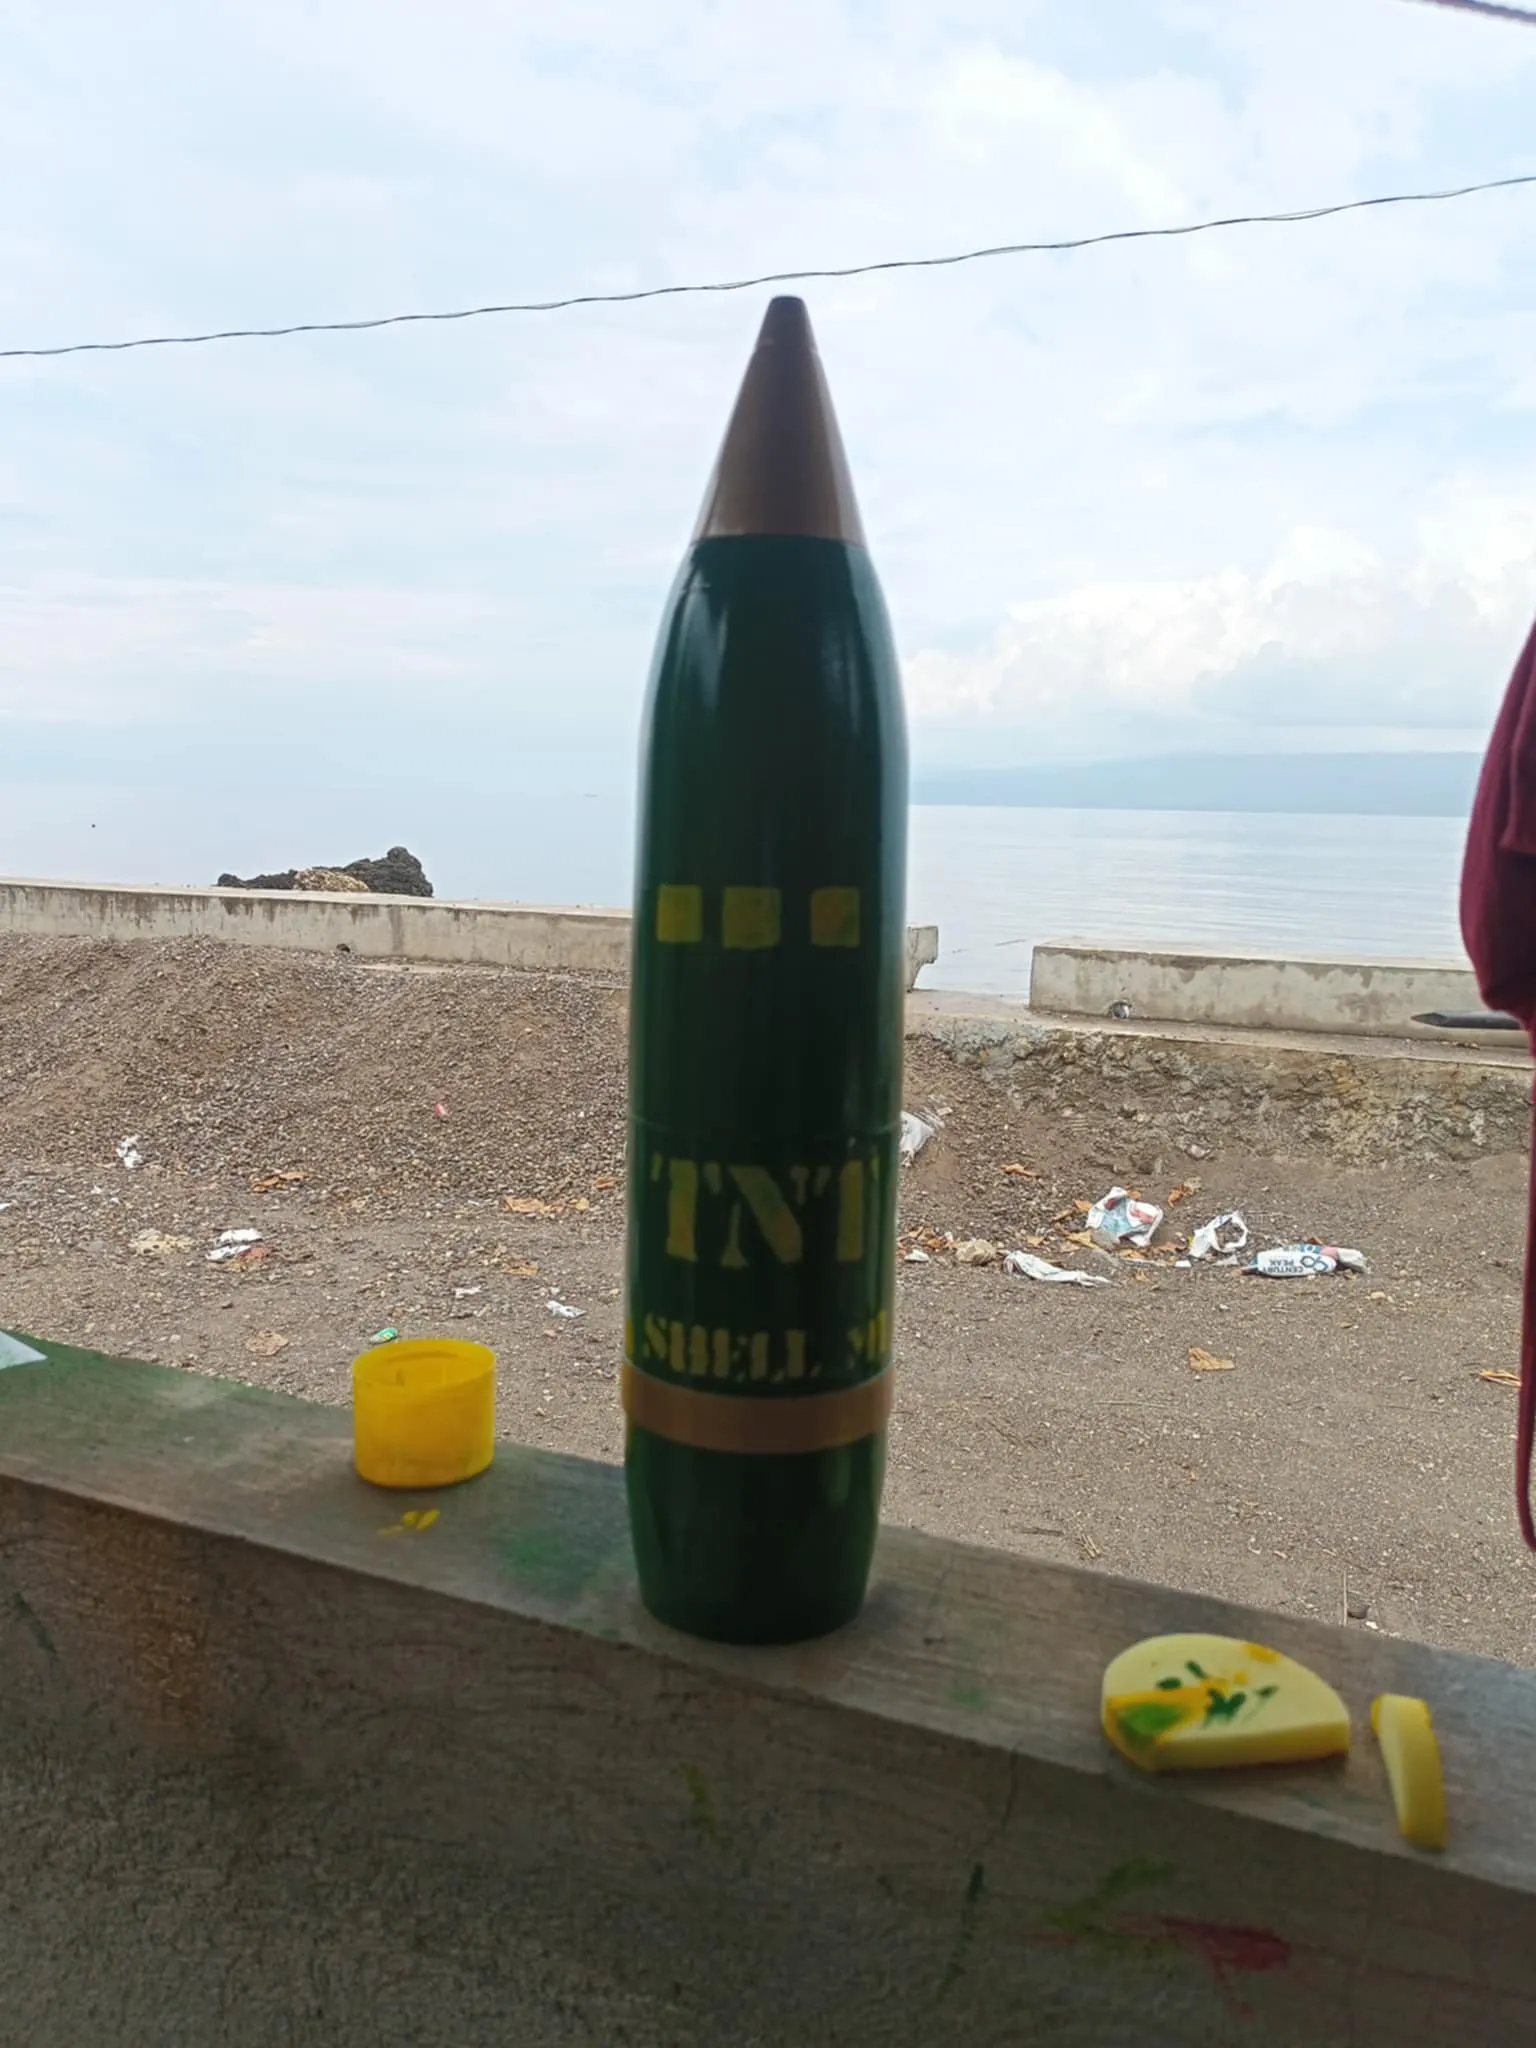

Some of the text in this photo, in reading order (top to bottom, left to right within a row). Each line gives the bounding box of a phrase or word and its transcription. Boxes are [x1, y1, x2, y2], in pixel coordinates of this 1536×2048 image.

[650, 1145, 880, 1269] TNT
[1262, 1265, 1304, 1274] CENTURY
[1269, 1259, 1295, 1267] PEAK
[643, 1312, 823, 1382] SHELL
